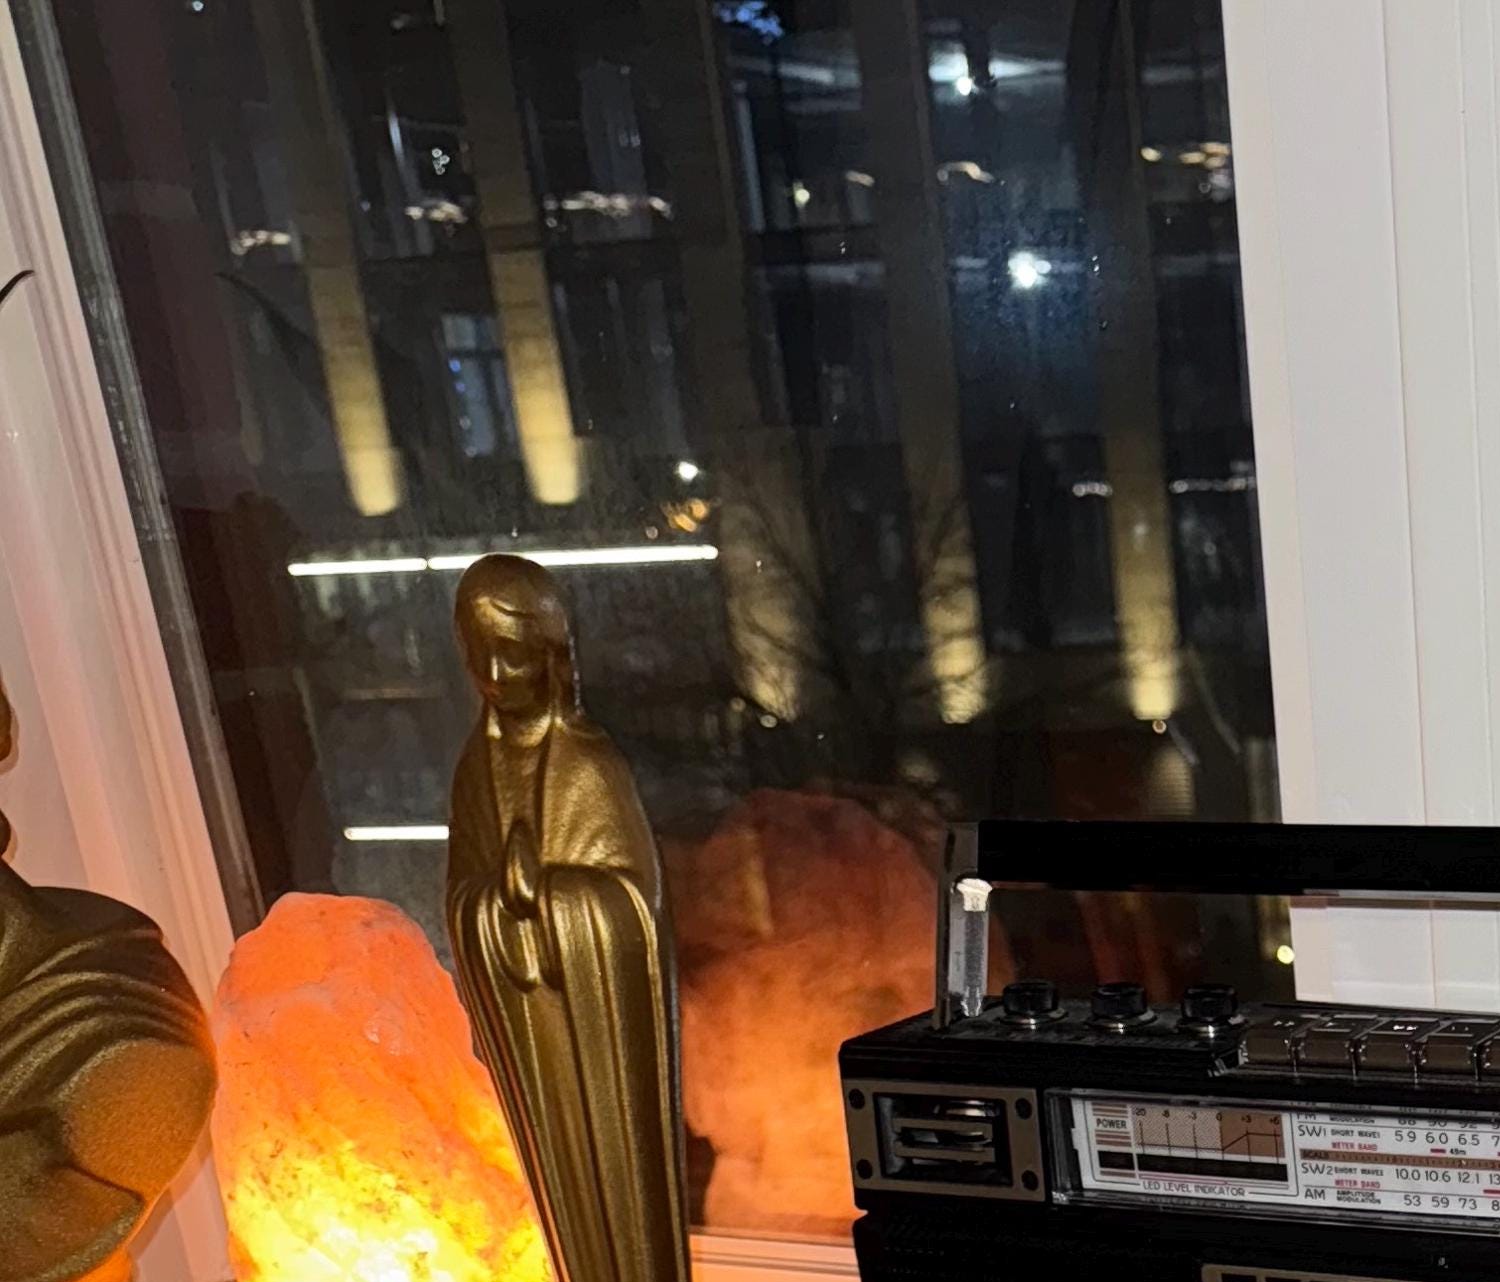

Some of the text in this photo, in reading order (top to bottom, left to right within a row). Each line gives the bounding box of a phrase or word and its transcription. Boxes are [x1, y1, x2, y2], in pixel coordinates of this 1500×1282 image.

[1096, 1118, 1127, 1129] POWER
[1143, 1181, 1245, 1197] LED LEVEL INDICATOR
[1304, 1188, 1326, 1200] AM
[1403, 1194, 1421, 1207] 53
[1431, 1196, 1450, 1208] 59
[1458, 1198, 1477, 1210] 73
